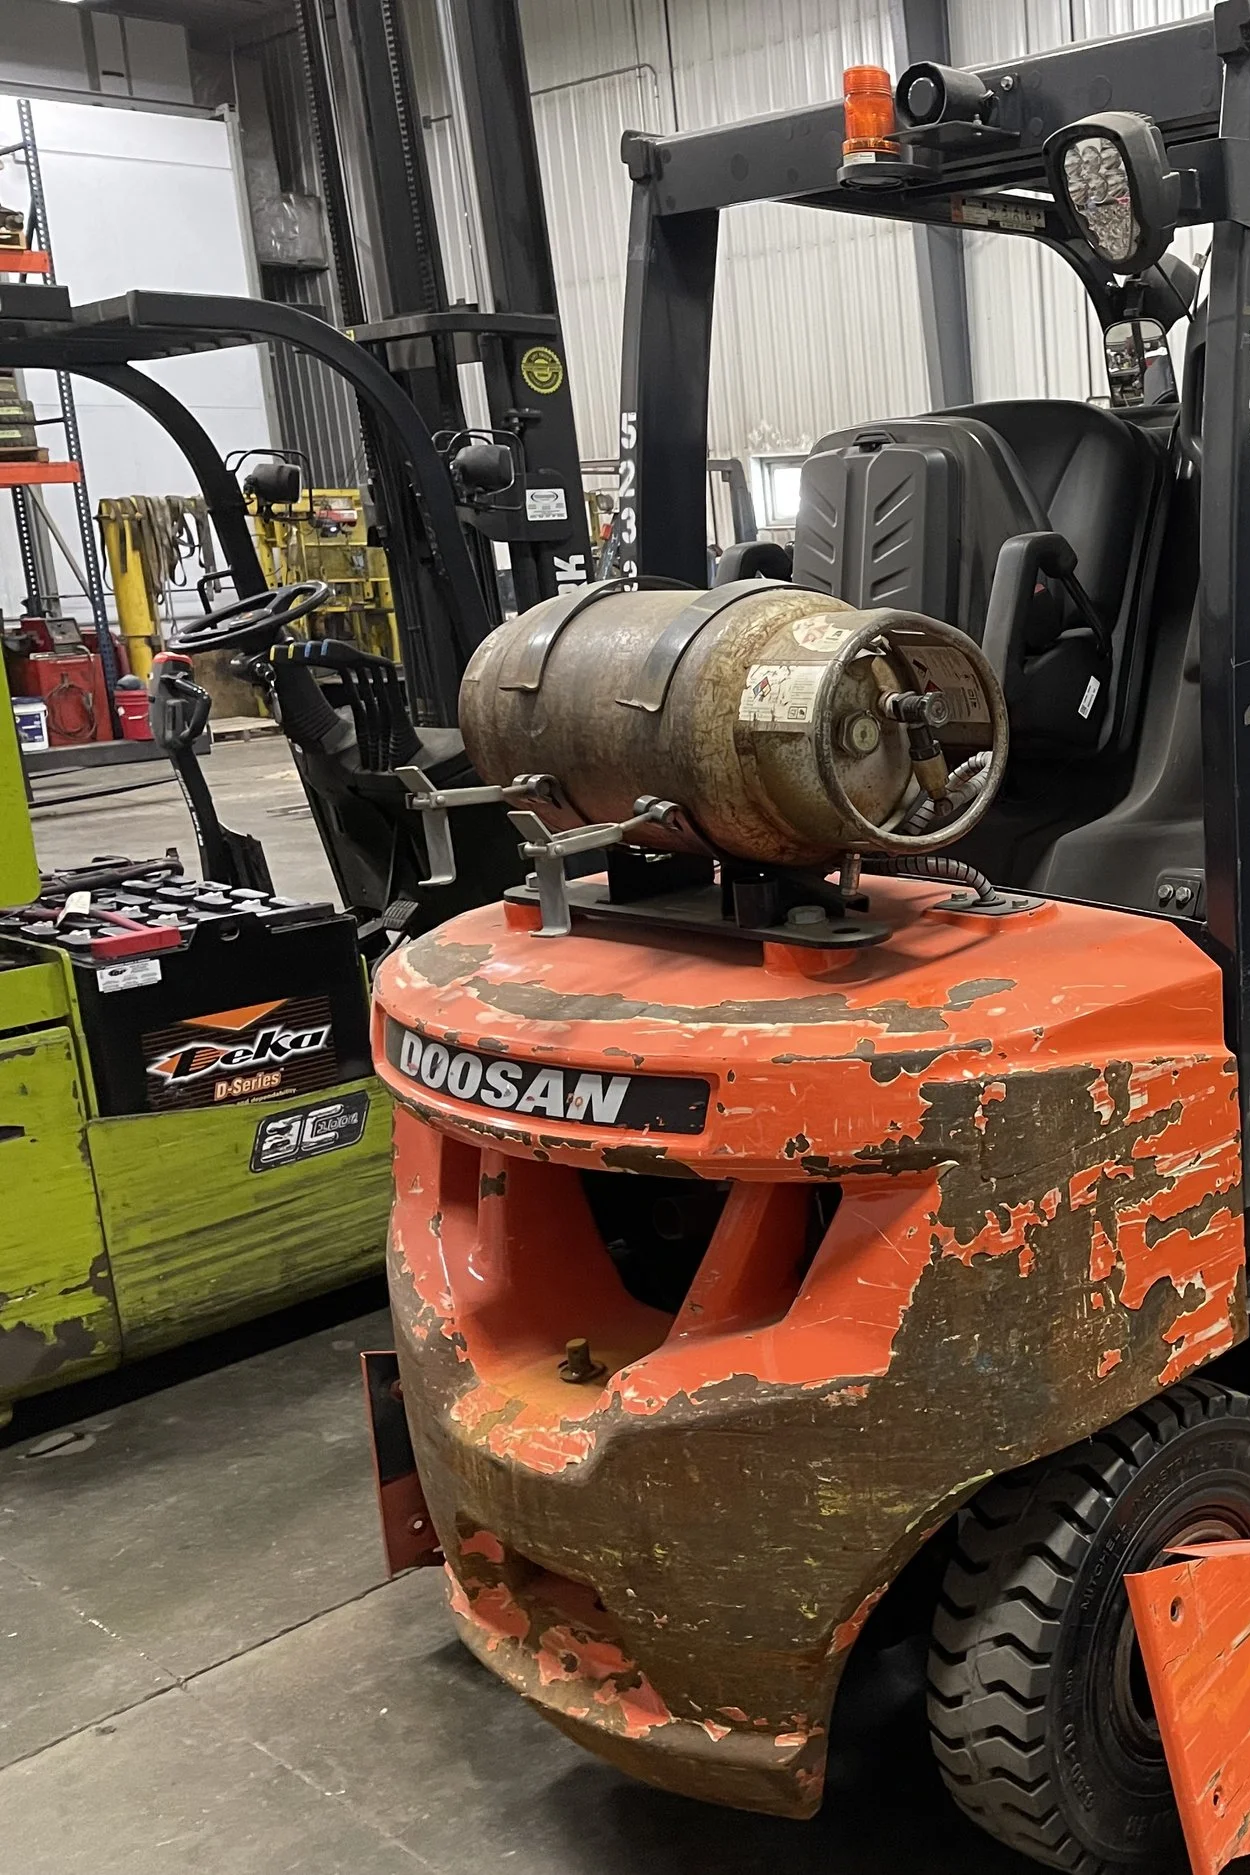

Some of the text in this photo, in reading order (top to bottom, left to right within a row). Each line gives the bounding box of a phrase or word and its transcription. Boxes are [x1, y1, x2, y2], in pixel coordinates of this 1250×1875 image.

[150, 1025, 331, 1082] Deka
[400, 1029, 632, 1124] DOOSAN
[214, 1070, 282, 1101] D-Series
